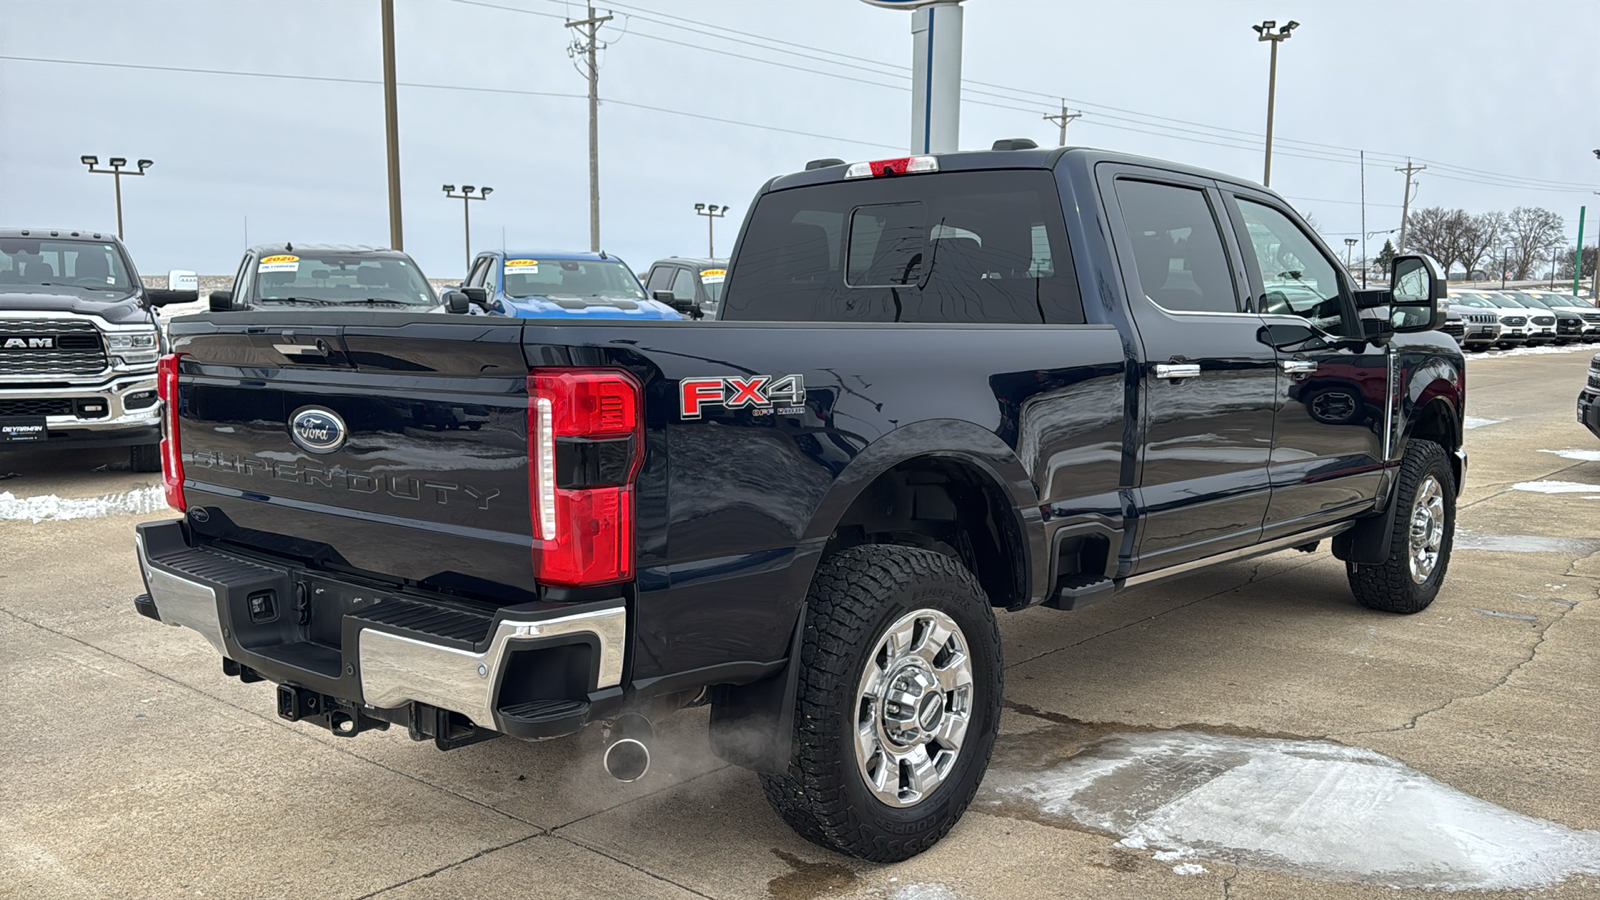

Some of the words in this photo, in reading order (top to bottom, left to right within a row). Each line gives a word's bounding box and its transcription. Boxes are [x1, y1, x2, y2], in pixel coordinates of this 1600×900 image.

[0, 338, 53, 348] AM
[680, 374, 806, 420] FX4
[301, 417, 329, 441] Ford
[191, 449, 333, 488] SUPER
[345, 469, 500, 510] DUTY
